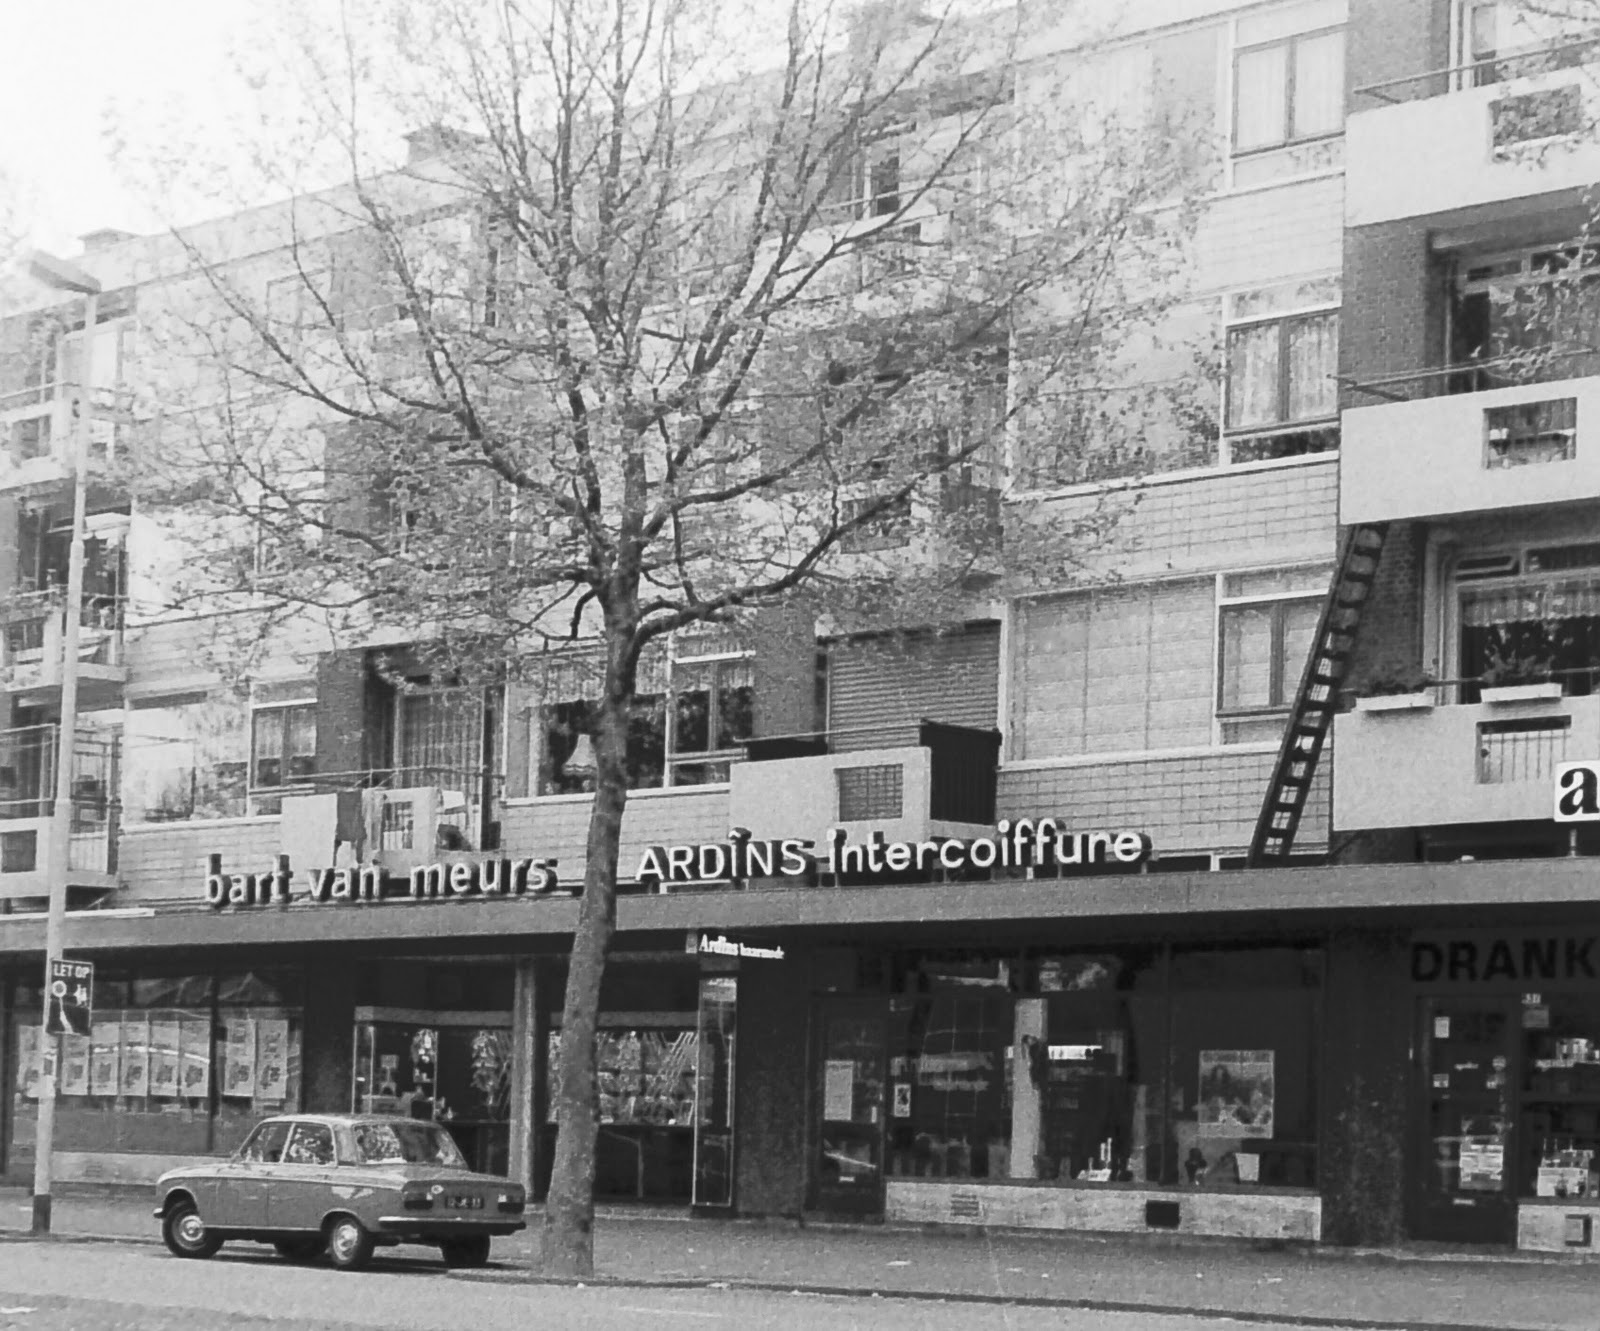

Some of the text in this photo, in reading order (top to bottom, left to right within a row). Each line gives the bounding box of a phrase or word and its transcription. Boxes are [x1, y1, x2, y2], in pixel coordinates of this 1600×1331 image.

[827, 818, 1147, 874] intercoiffure
[205, 853, 555, 904] bart van meurs
[53, 963, 90, 979] LET OP
[1411, 937, 1598, 982] DRANK
